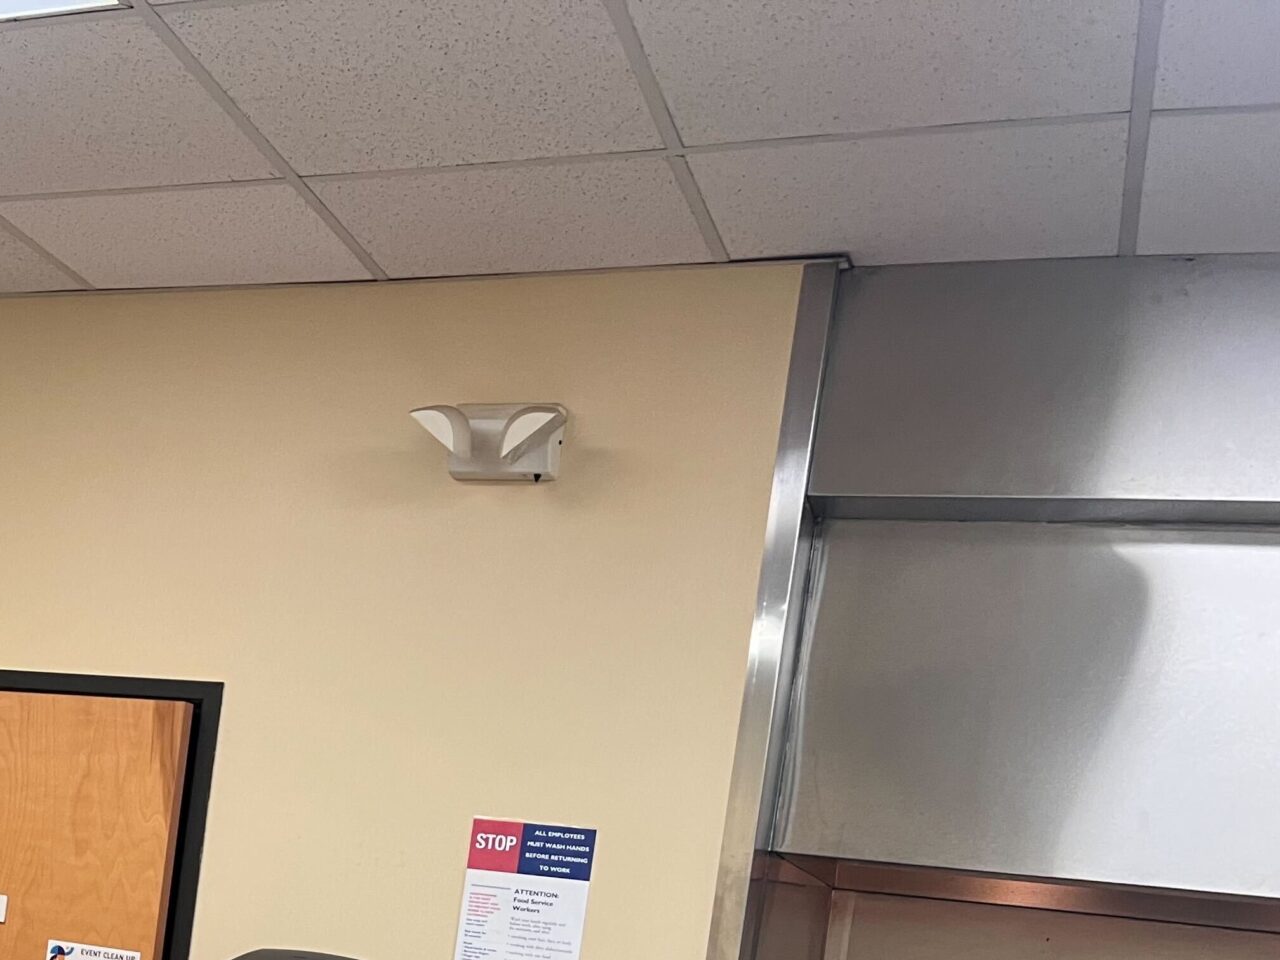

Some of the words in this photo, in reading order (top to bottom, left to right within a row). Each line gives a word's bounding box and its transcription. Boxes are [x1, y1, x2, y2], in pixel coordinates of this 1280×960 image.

[548, 832, 585, 840] EMPLOYEES
[476, 833, 517, 852] STOP
[545, 842, 566, 850] WASH
[566, 844, 590, 852] HANDS
[525, 852, 549, 860] BEFORE
[550, 854, 588, 864] RETURNING
[540, 864, 549, 872] TO
[550, 866, 570, 874] WORK
[514, 888, 559, 899] ATTENTION:
[514, 897, 530, 905] Food
[530, 899, 554, 907] Service
[512, 905, 540, 914] Workers
[80, 948, 101, 958] EVENT
[103, 951, 124, 960] CLEAN
